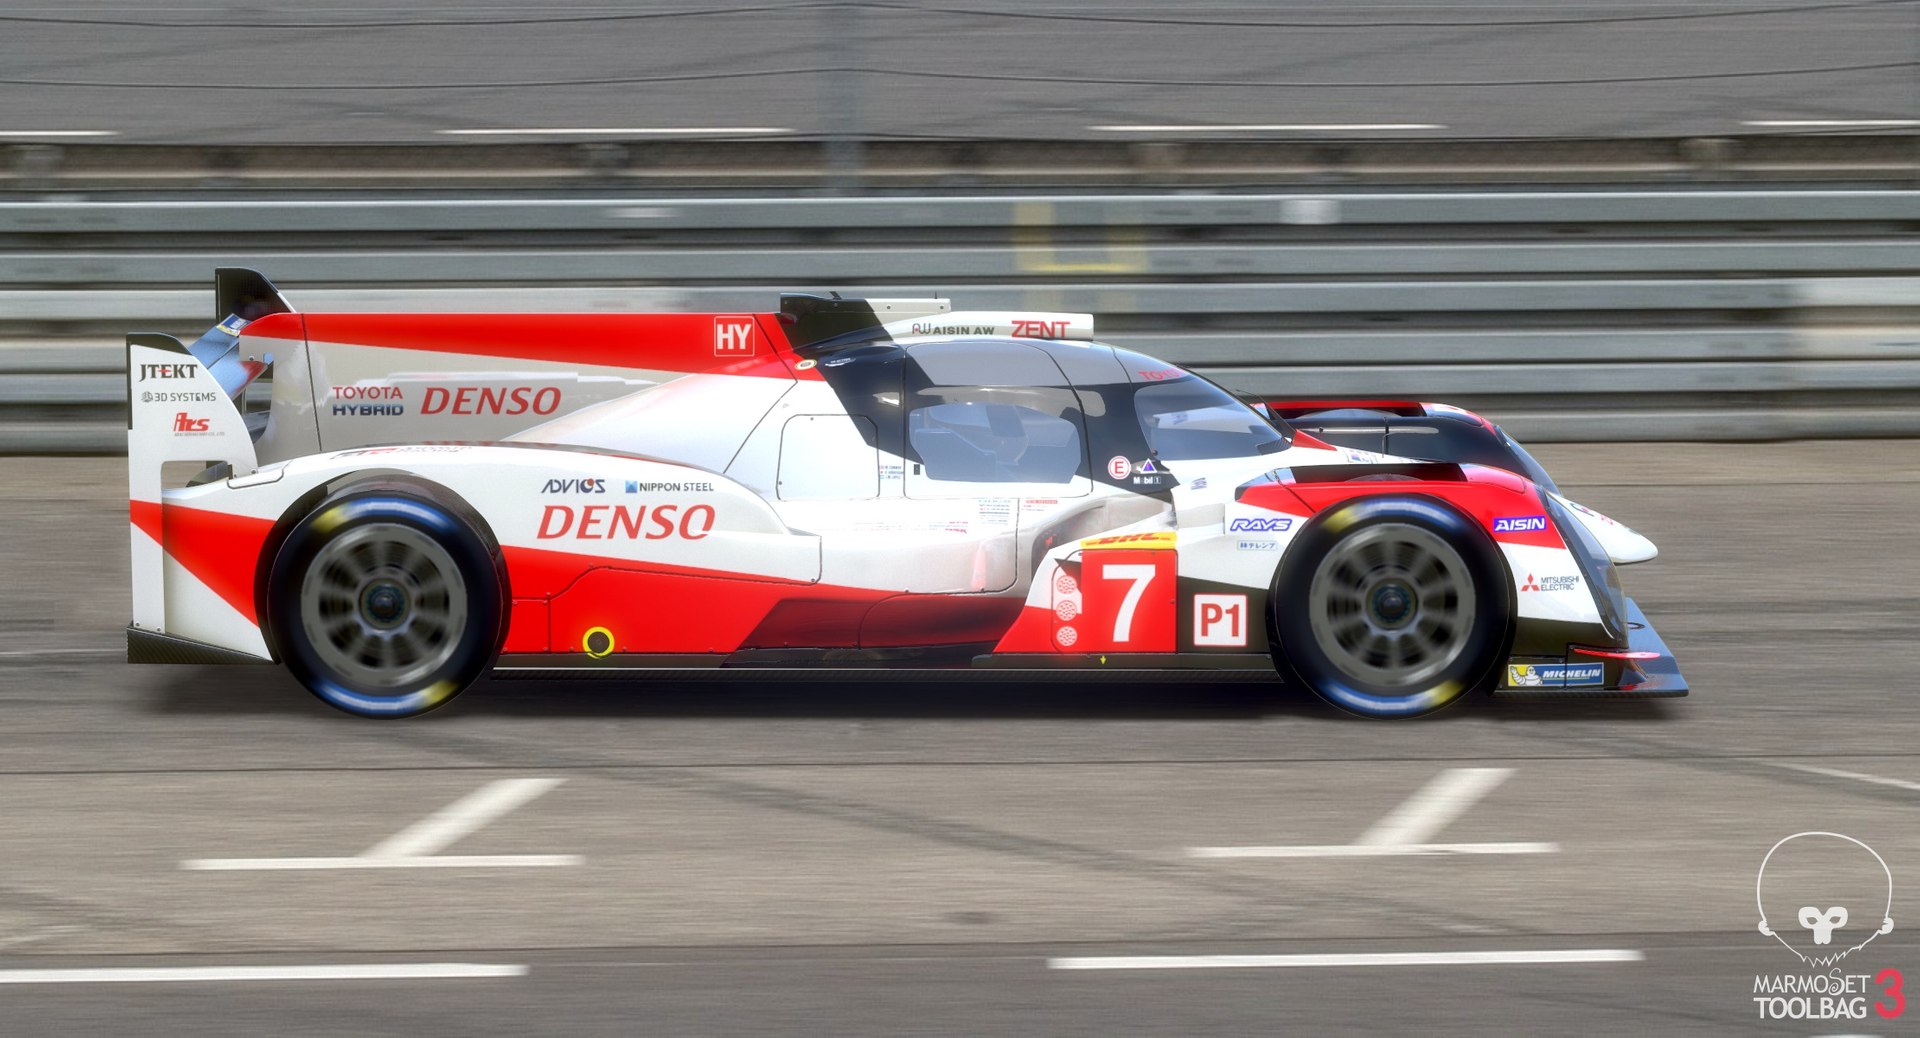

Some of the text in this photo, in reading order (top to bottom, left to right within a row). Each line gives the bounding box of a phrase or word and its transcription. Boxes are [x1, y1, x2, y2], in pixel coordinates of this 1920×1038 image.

[933, 326, 970, 335] AISIN
[974, 326, 995, 335] AW
[1011, 320, 1071, 338] ZENT
[716, 323, 752, 350] HY
[139, 364, 198, 382] JTEKT
[155, 392, 217, 402] 3D SYSTEMS
[332, 386, 404, 399] TOYOTA
[420, 387, 562, 416] DENSO
[332, 403, 404, 416] HYBRID
[639, 482, 714, 492] NIPPON STEEL
[536, 504, 716, 540] DENSO
[1229, 518, 1293, 531] RAYS
[1494, 517, 1546, 531] AISIN
[1098, 532, 1160, 545] DHL
[1541, 575, 1579, 583] MITSUBISHI
[1541, 583, 1575, 591] ELECTRIC
[1102, 564, 1156, 642] 7
[1200, 603, 1240, 637] P1
[1542, 669, 1601, 678] MICHELIN
